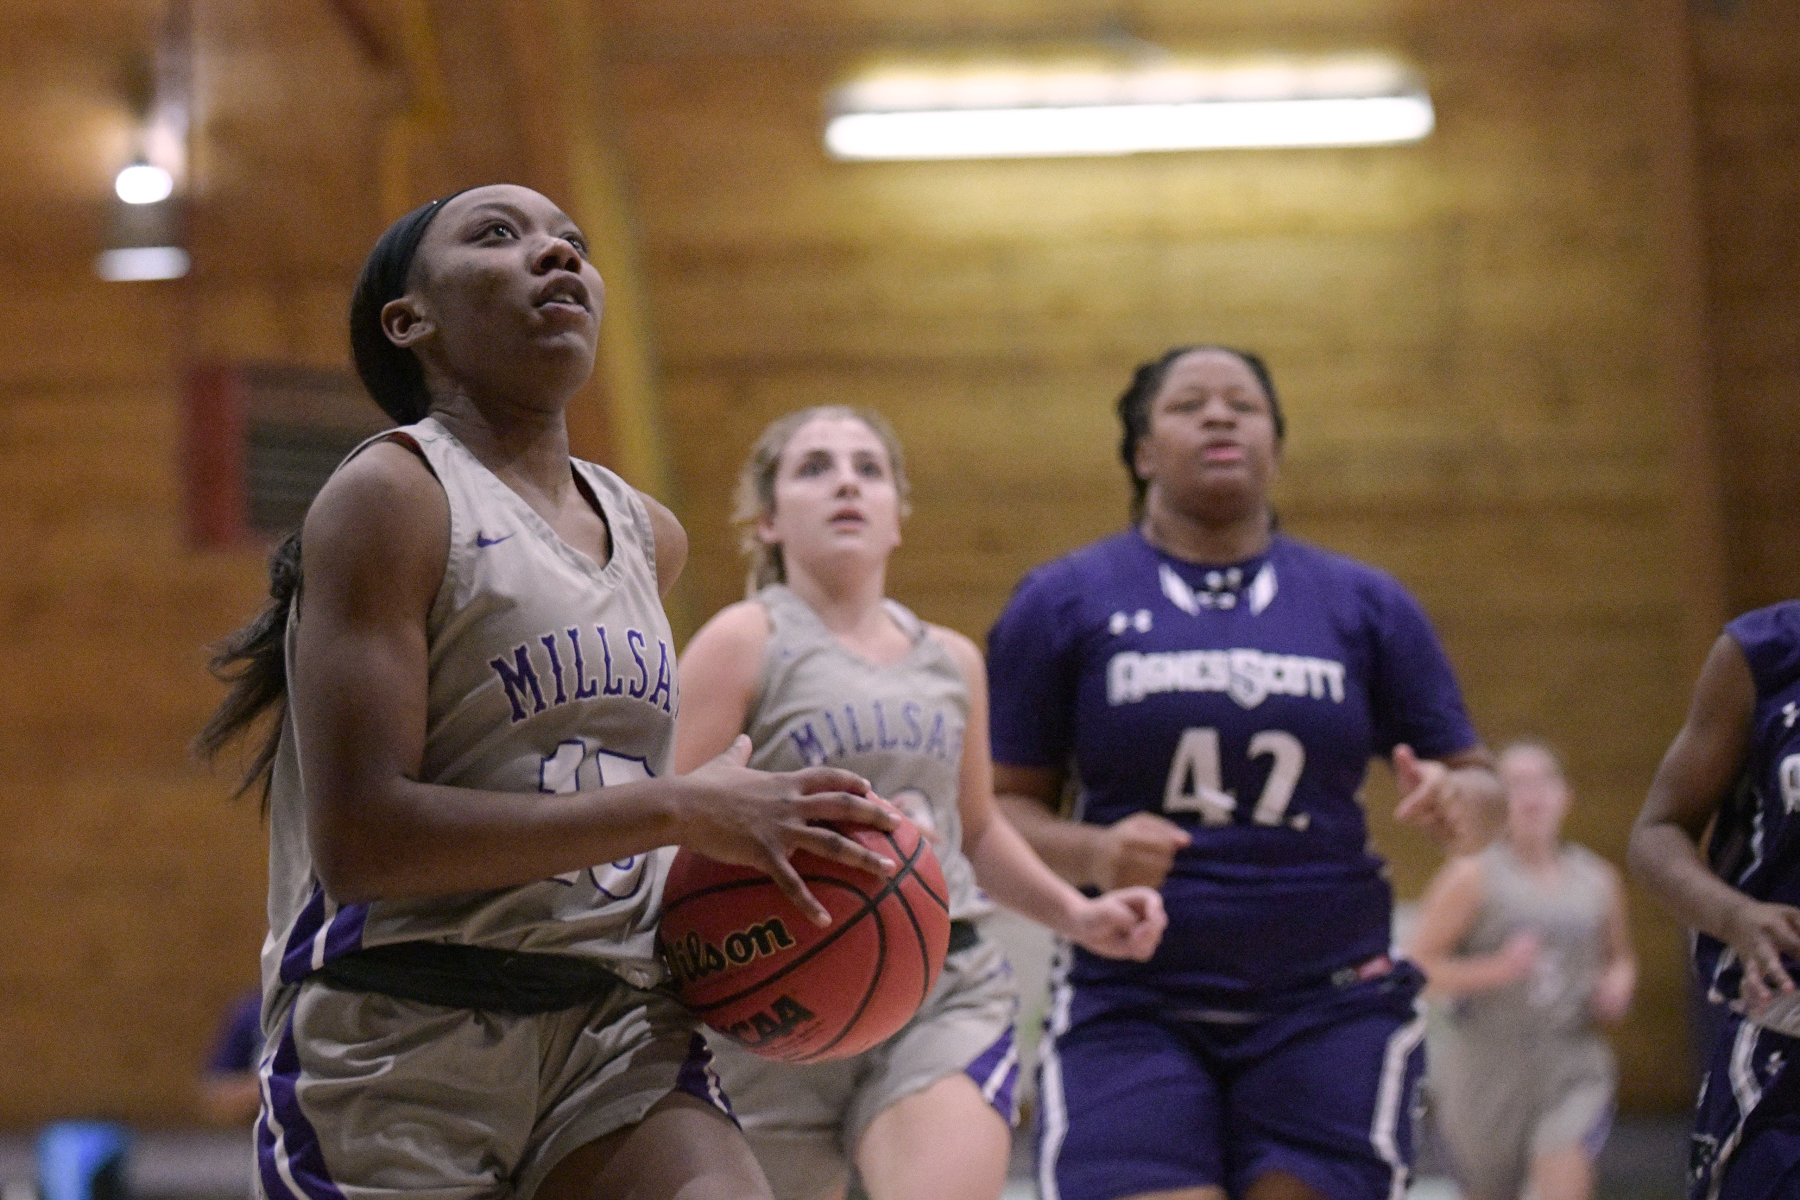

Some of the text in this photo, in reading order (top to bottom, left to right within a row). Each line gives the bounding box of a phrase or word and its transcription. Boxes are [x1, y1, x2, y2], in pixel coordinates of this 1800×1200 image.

[489, 624, 680, 724] MILLSA
[1162, 727, 1311, 832] 42
[666, 915, 797, 983] ilson
[719, 993, 816, 1047] CAA
